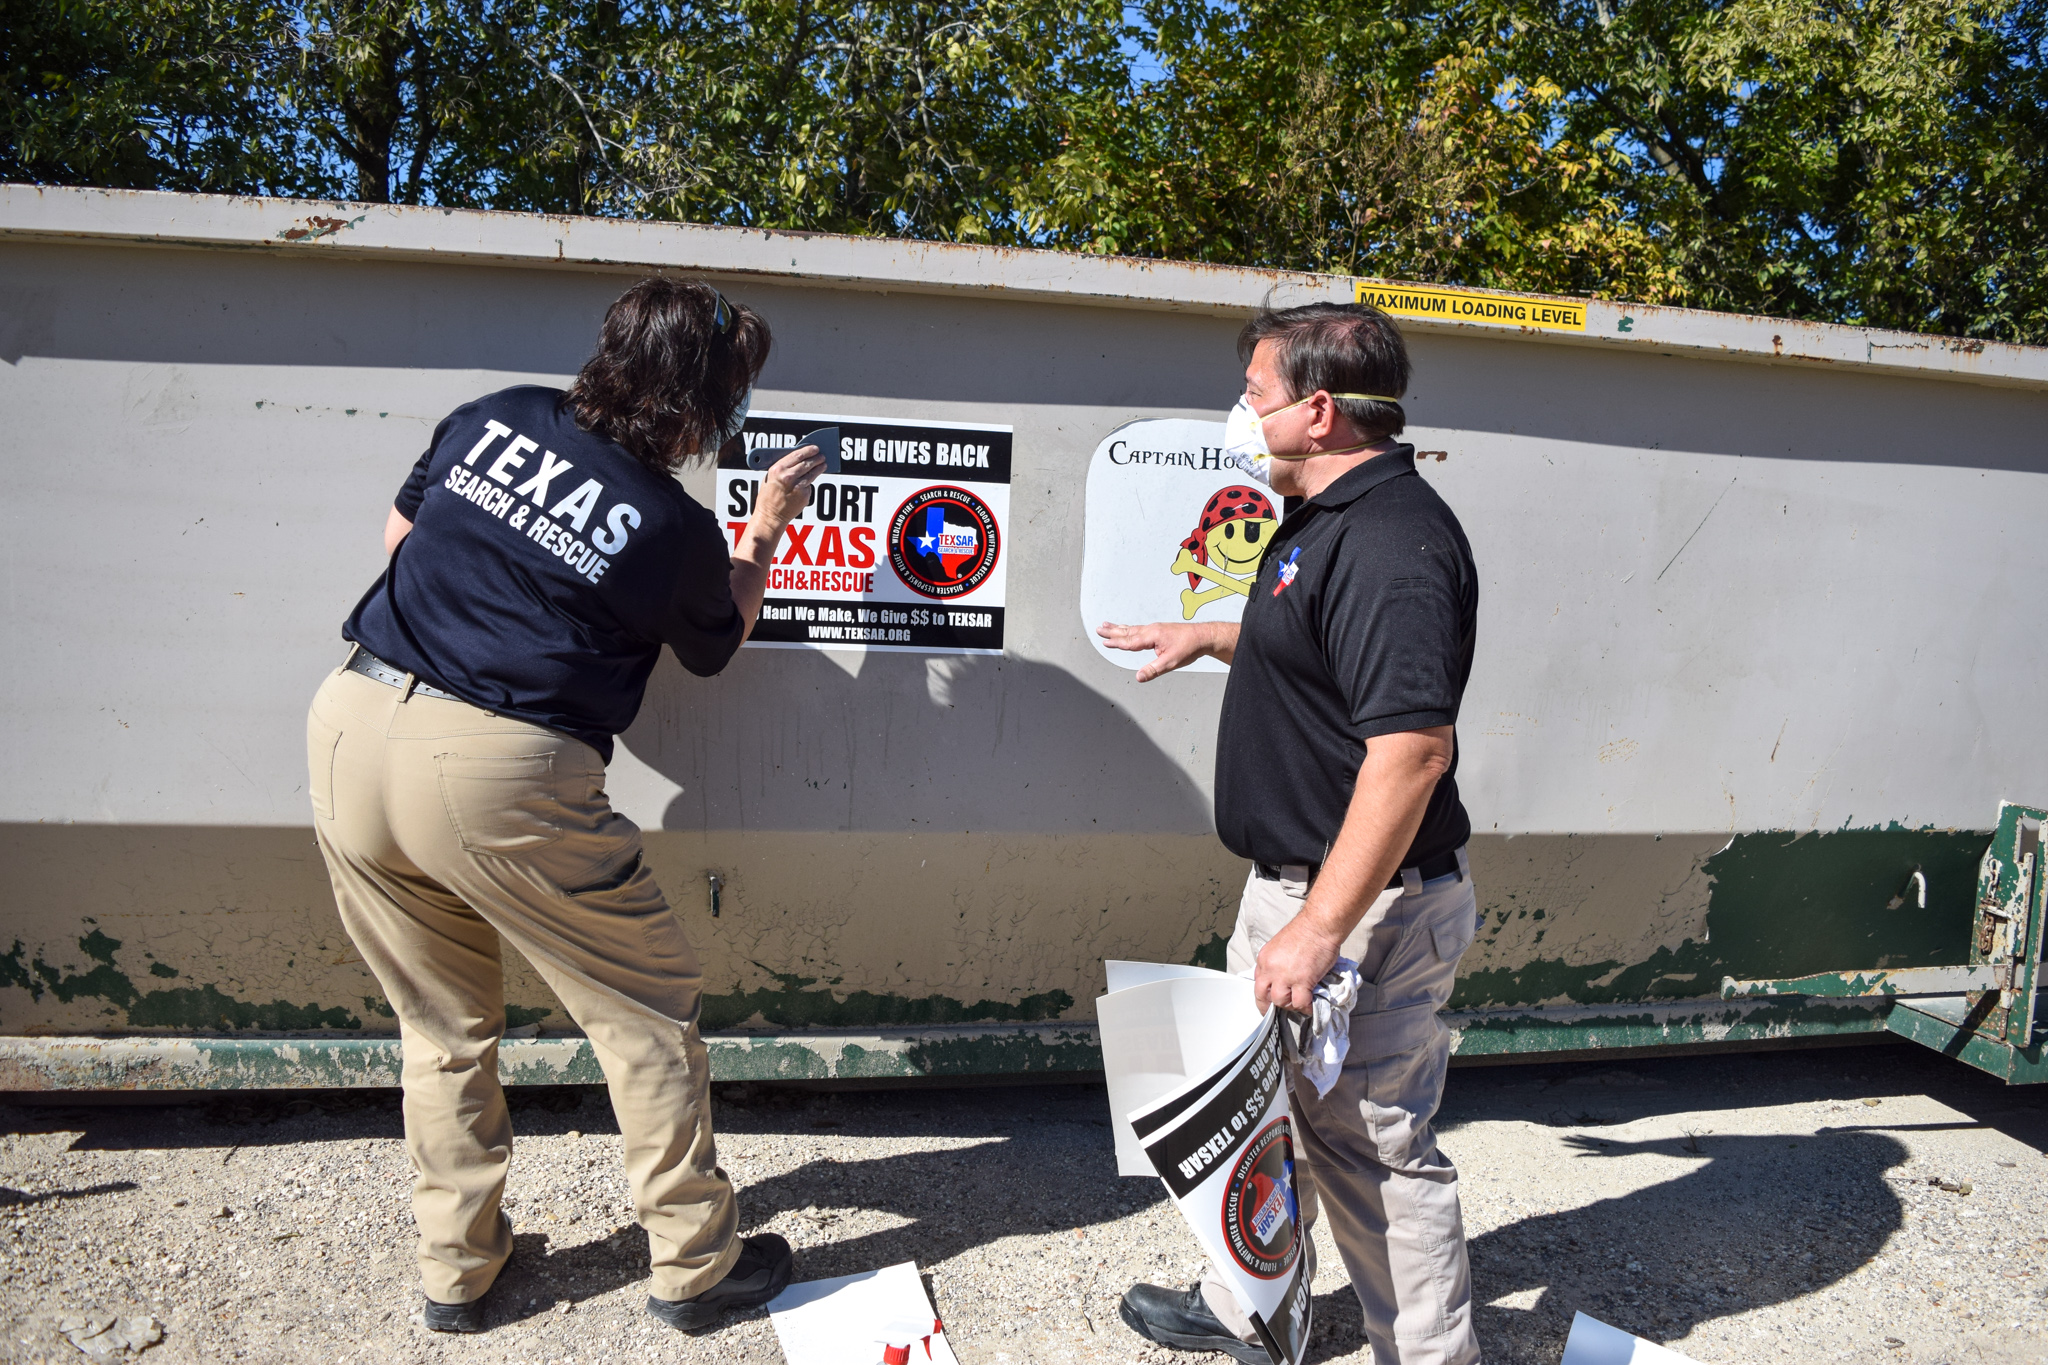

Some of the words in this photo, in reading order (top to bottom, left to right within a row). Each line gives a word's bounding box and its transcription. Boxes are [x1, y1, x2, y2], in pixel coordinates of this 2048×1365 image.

[1360, 292, 1446, 313] MAXIMUM
[1452, 300, 1526, 320] LOADING
[1532, 308, 1582, 326] LEVEL
[873, 438, 931, 464] GIVES
[936, 442, 990, 468] BACK
[463, 418, 642, 555] TEXAS
[919, 490, 942, 502] SEARCH
[949, 490, 971, 504] RESCUE
[444, 465, 516, 519] SEARCH
[508, 505, 531, 531] &
[526, 515, 611, 585] RESCUE
[891, 514, 905, 544] WILDLAND
[903, 502, 915, 516] FIRE
[975, 505, 990, 524] FLOOD
[939, 534, 974, 546] TEXSAR
[984, 530, 996, 567] SWIFTWATER
[893, 553, 906, 569] RELIEF
[907, 575, 935, 593] RESPONSE
[936, 584, 964, 594] DISASTER
[969, 567, 988, 585] RESCUE
[762, 605, 792, 621] Haul
[795, 606, 815, 621] We
[818, 607, 855, 624] Make,
[857, 608, 877, 623] We
[880, 609, 908, 624] Give
[910, 608, 929, 626] $$
[932, 612, 945, 625] to
[948, 612, 992, 627] TEXSAR
[808, 626, 910, 641] WWW.TEXSAR.ORG
[1246, 1088, 1265, 1119] $$
[1230, 1110, 1248, 1132] to
[1177, 1126, 1236, 1180] TEXSAR
[1237, 1144, 1261, 1180] DISASTER
[1259, 1125, 1283, 1145] RESPONSE
[1228, 1191, 1239, 1222] RESCUE
[1257, 1192, 1286, 1236] TEXSAR
[1229, 1223, 1255, 1265] SWIFTWATER
[1254, 1260, 1259, 1268] &
[1260, 1262, 1277, 1272] FLOOD
